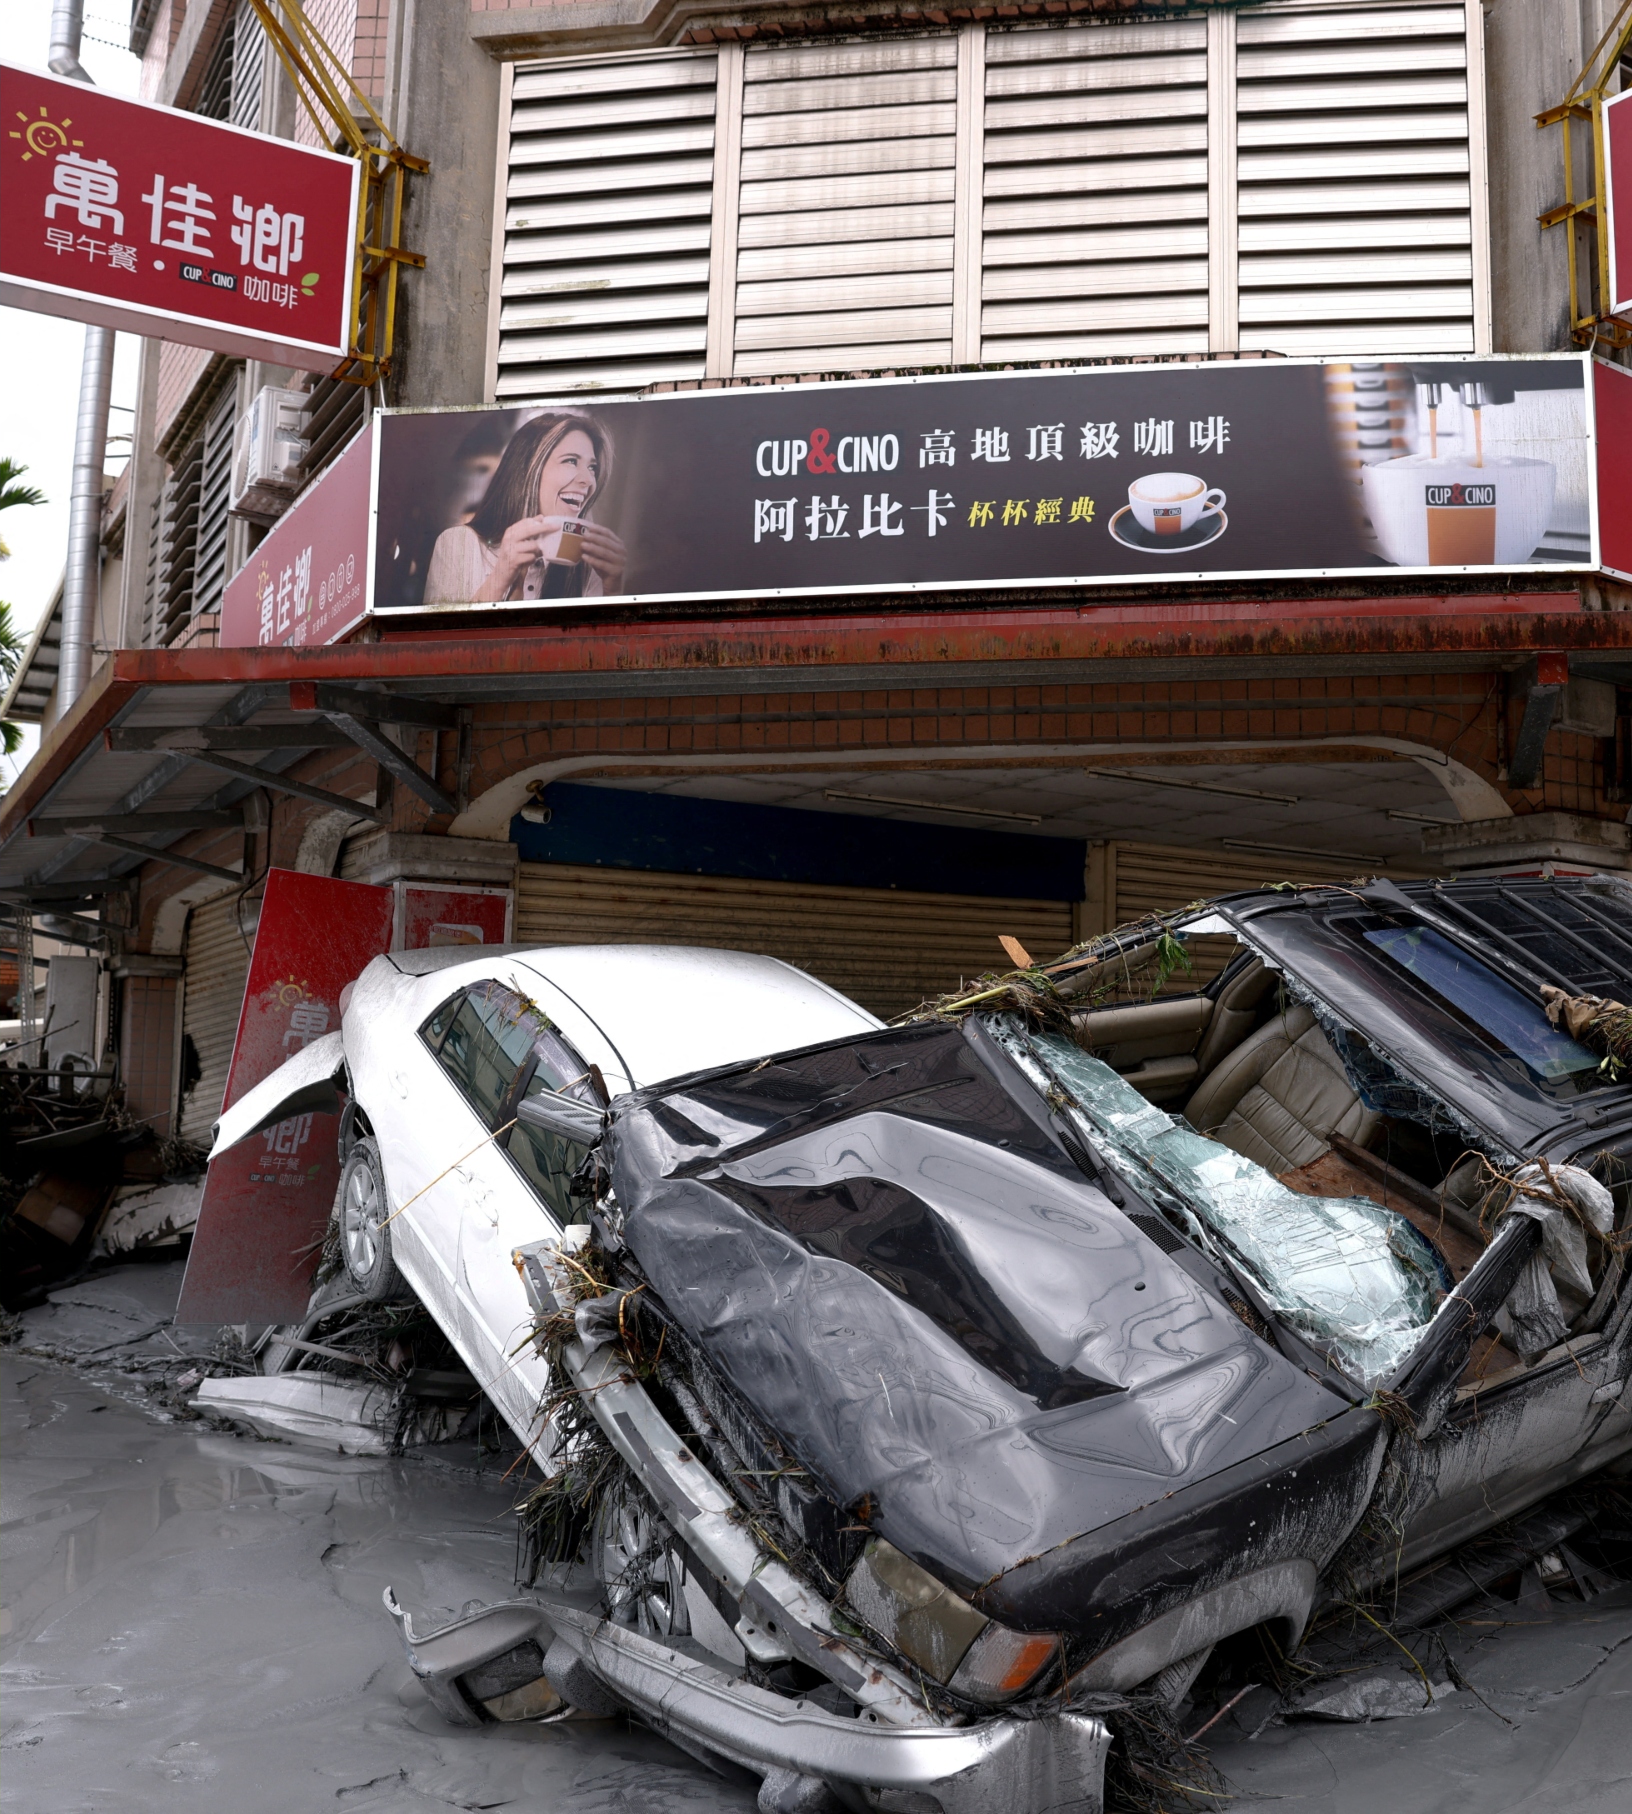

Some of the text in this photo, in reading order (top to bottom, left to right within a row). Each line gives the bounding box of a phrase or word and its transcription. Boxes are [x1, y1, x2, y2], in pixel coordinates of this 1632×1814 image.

[44, 151, 305, 276] 萬佳鄉
[44, 227, 298, 309] 早午餐 CUP&CINO 咖啡
[756, 416, 1231, 477] CUP&CINO 高地頂級咖啡
[754, 489, 1096, 543] 阿拉比卡 杯杯經典
[1428, 483, 1493, 505] CUP&CINO
[259, 545, 312, 645] 萬佳鄉
[258, 1155, 300, 1171] 早午餐
[279, 1173, 305, 1187] 咖啡
